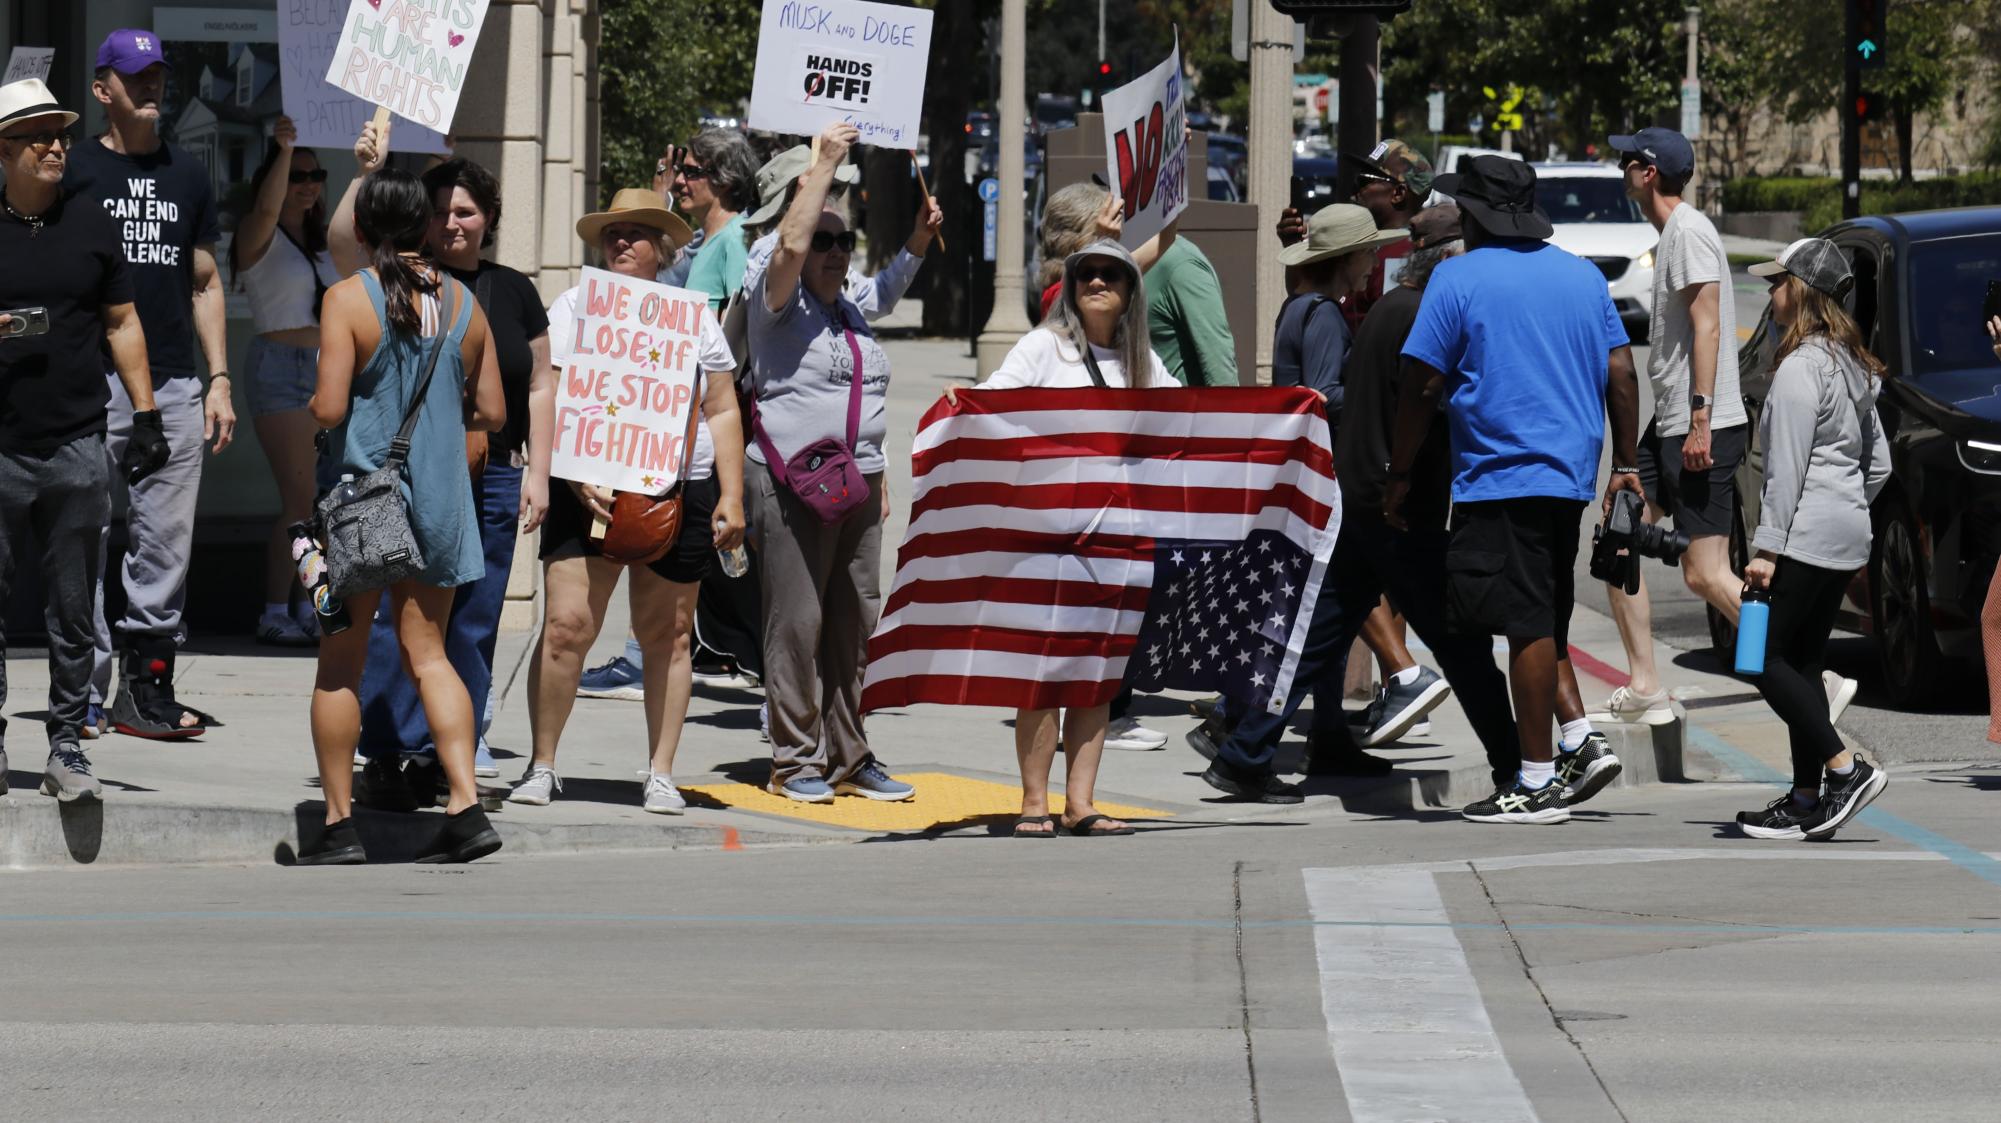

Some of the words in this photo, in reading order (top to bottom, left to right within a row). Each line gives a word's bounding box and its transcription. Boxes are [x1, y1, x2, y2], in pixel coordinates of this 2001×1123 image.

[383, 0, 437, 45] ARE
[779, 1, 832, 34] MUSK
[835, 24, 856, 39] AND
[863, 16, 916, 47] DOGE
[351, 13, 464, 91] HUMAN
[806, 55, 873, 77] HANDS
[340, 47, 445, 127] RIGHTS
[804, 72, 871, 103] OFF!
[845, 115, 905, 142] erything!
[1114, 101, 1164, 223] NO
[127, 178, 156, 199] WE
[145, 200, 178, 222] END
[123, 220, 161, 242] GUN
[586, 278, 632, 321] WE
[639, 292, 706, 337] ONLY
[573, 318, 648, 364] LOSE
[567, 364, 611, 402] WE
[617, 373, 691, 417] STOP
[552, 406, 684, 474] FIGHTING
